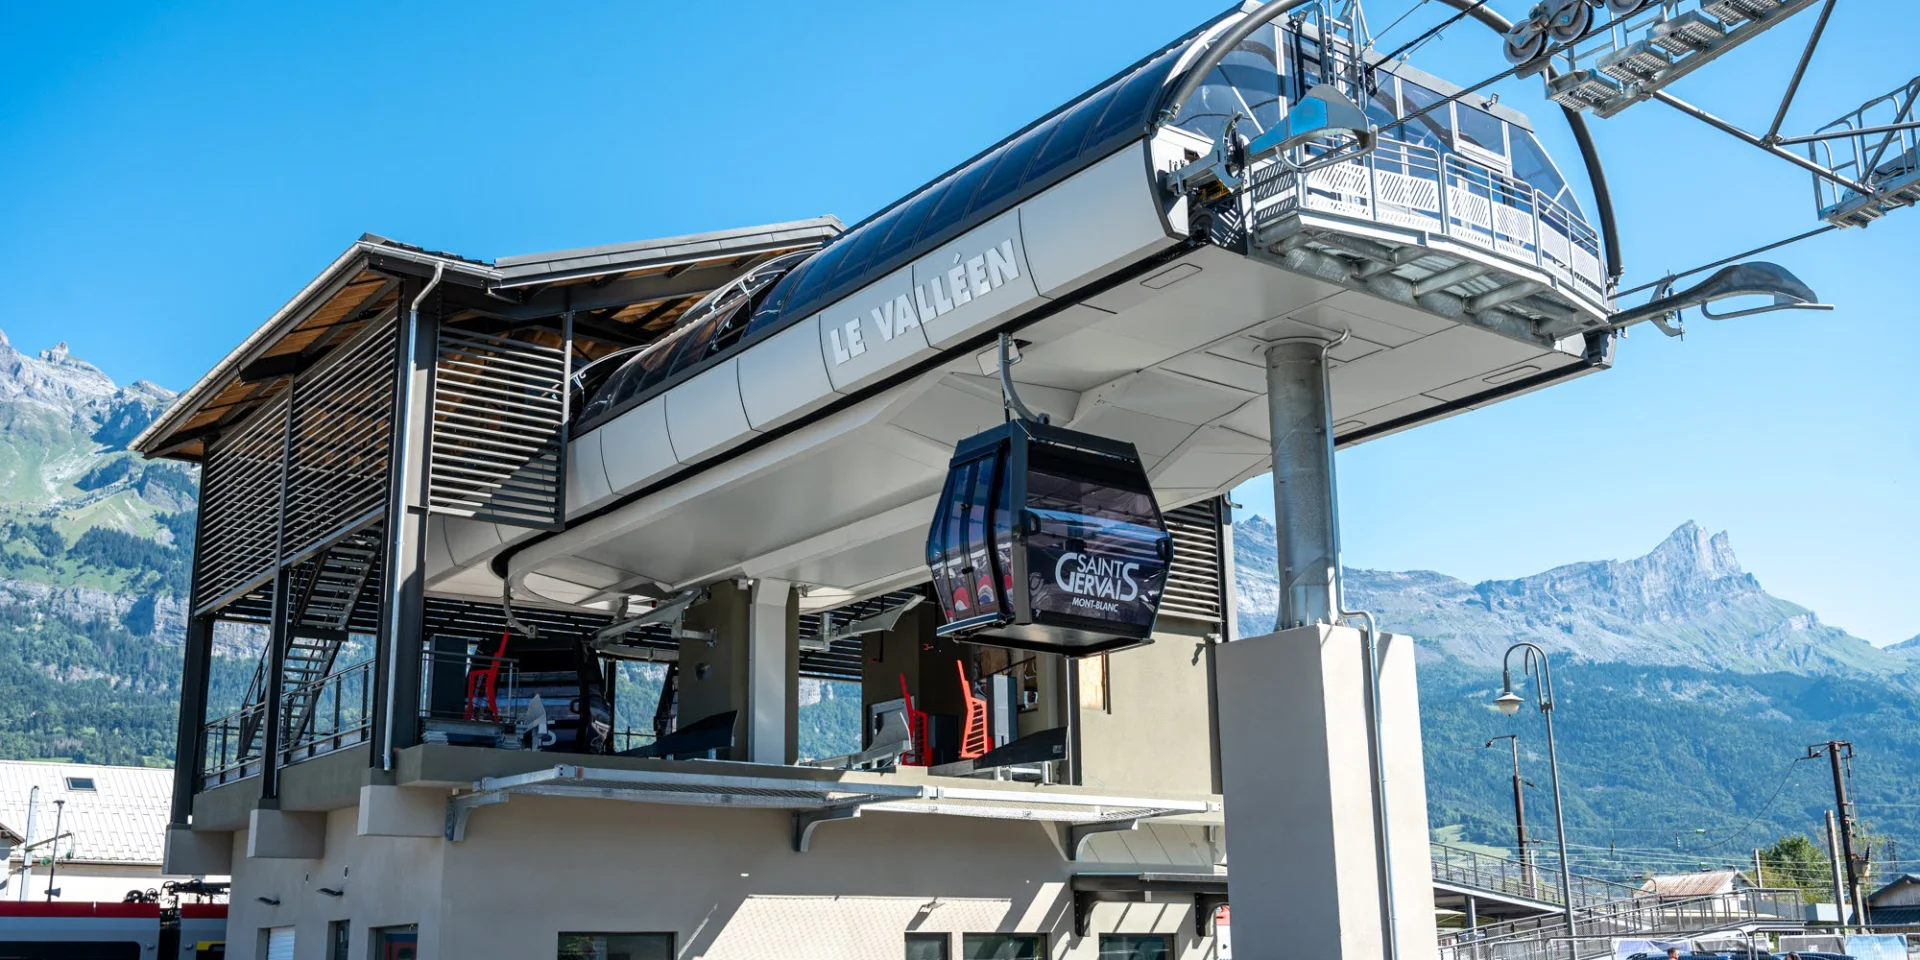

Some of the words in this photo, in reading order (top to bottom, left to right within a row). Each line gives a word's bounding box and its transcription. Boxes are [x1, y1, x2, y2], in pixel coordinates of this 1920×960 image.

[830, 317, 867, 366] LE
[871, 238, 1021, 342] VALLÉEN
[1055, 552, 1140, 601] GERVAIS
[1077, 554, 1124, 578] SAINT
[1072, 597, 1119, 613] MONT-BLANC
